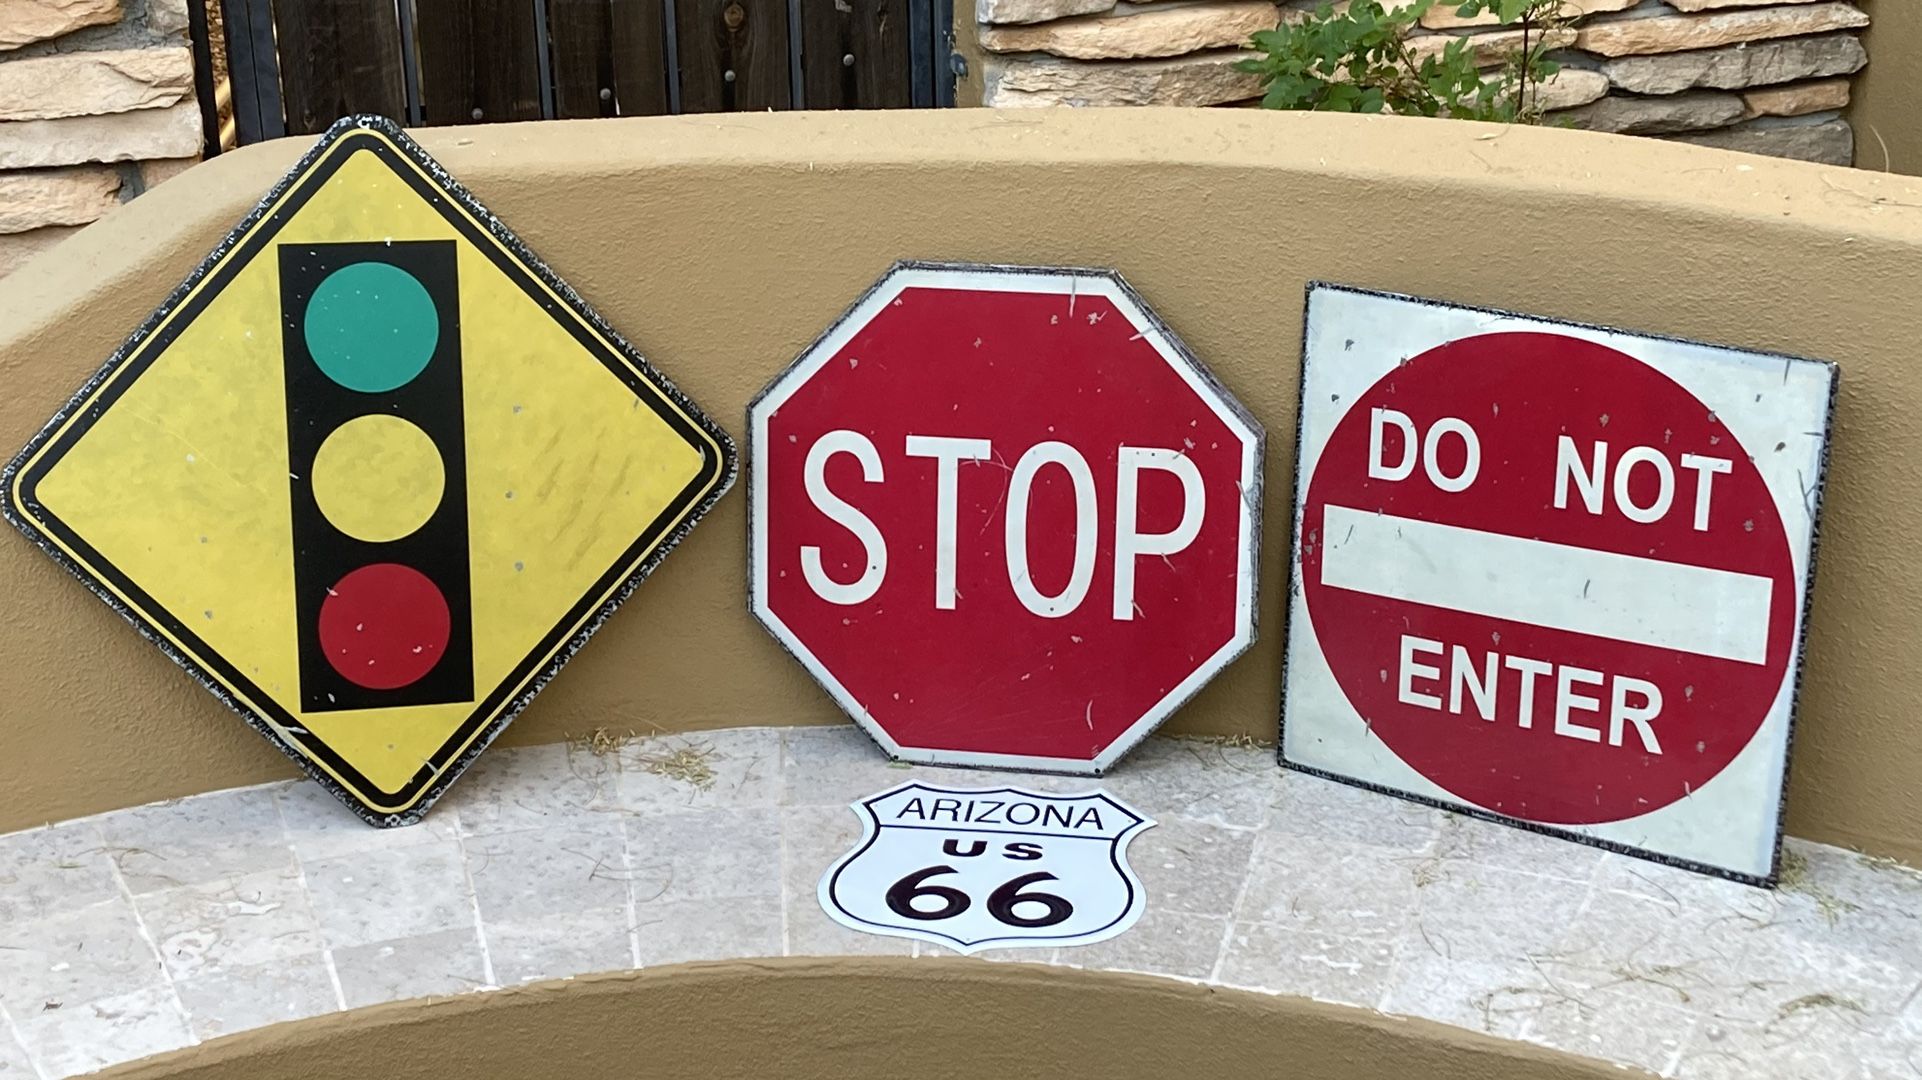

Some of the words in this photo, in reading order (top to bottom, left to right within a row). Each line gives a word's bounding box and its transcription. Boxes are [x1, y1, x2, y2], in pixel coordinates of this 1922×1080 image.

[1367, 407, 1481, 493] DO
[1553, 435, 1733, 532] NOT
[800, 429, 1206, 621] STOP
[1397, 634, 1663, 755] ENTER
[896, 797, 1105, 830] ARIZONA
[942, 838, 1044, 861] US
[885, 865, 1074, 928] 66
